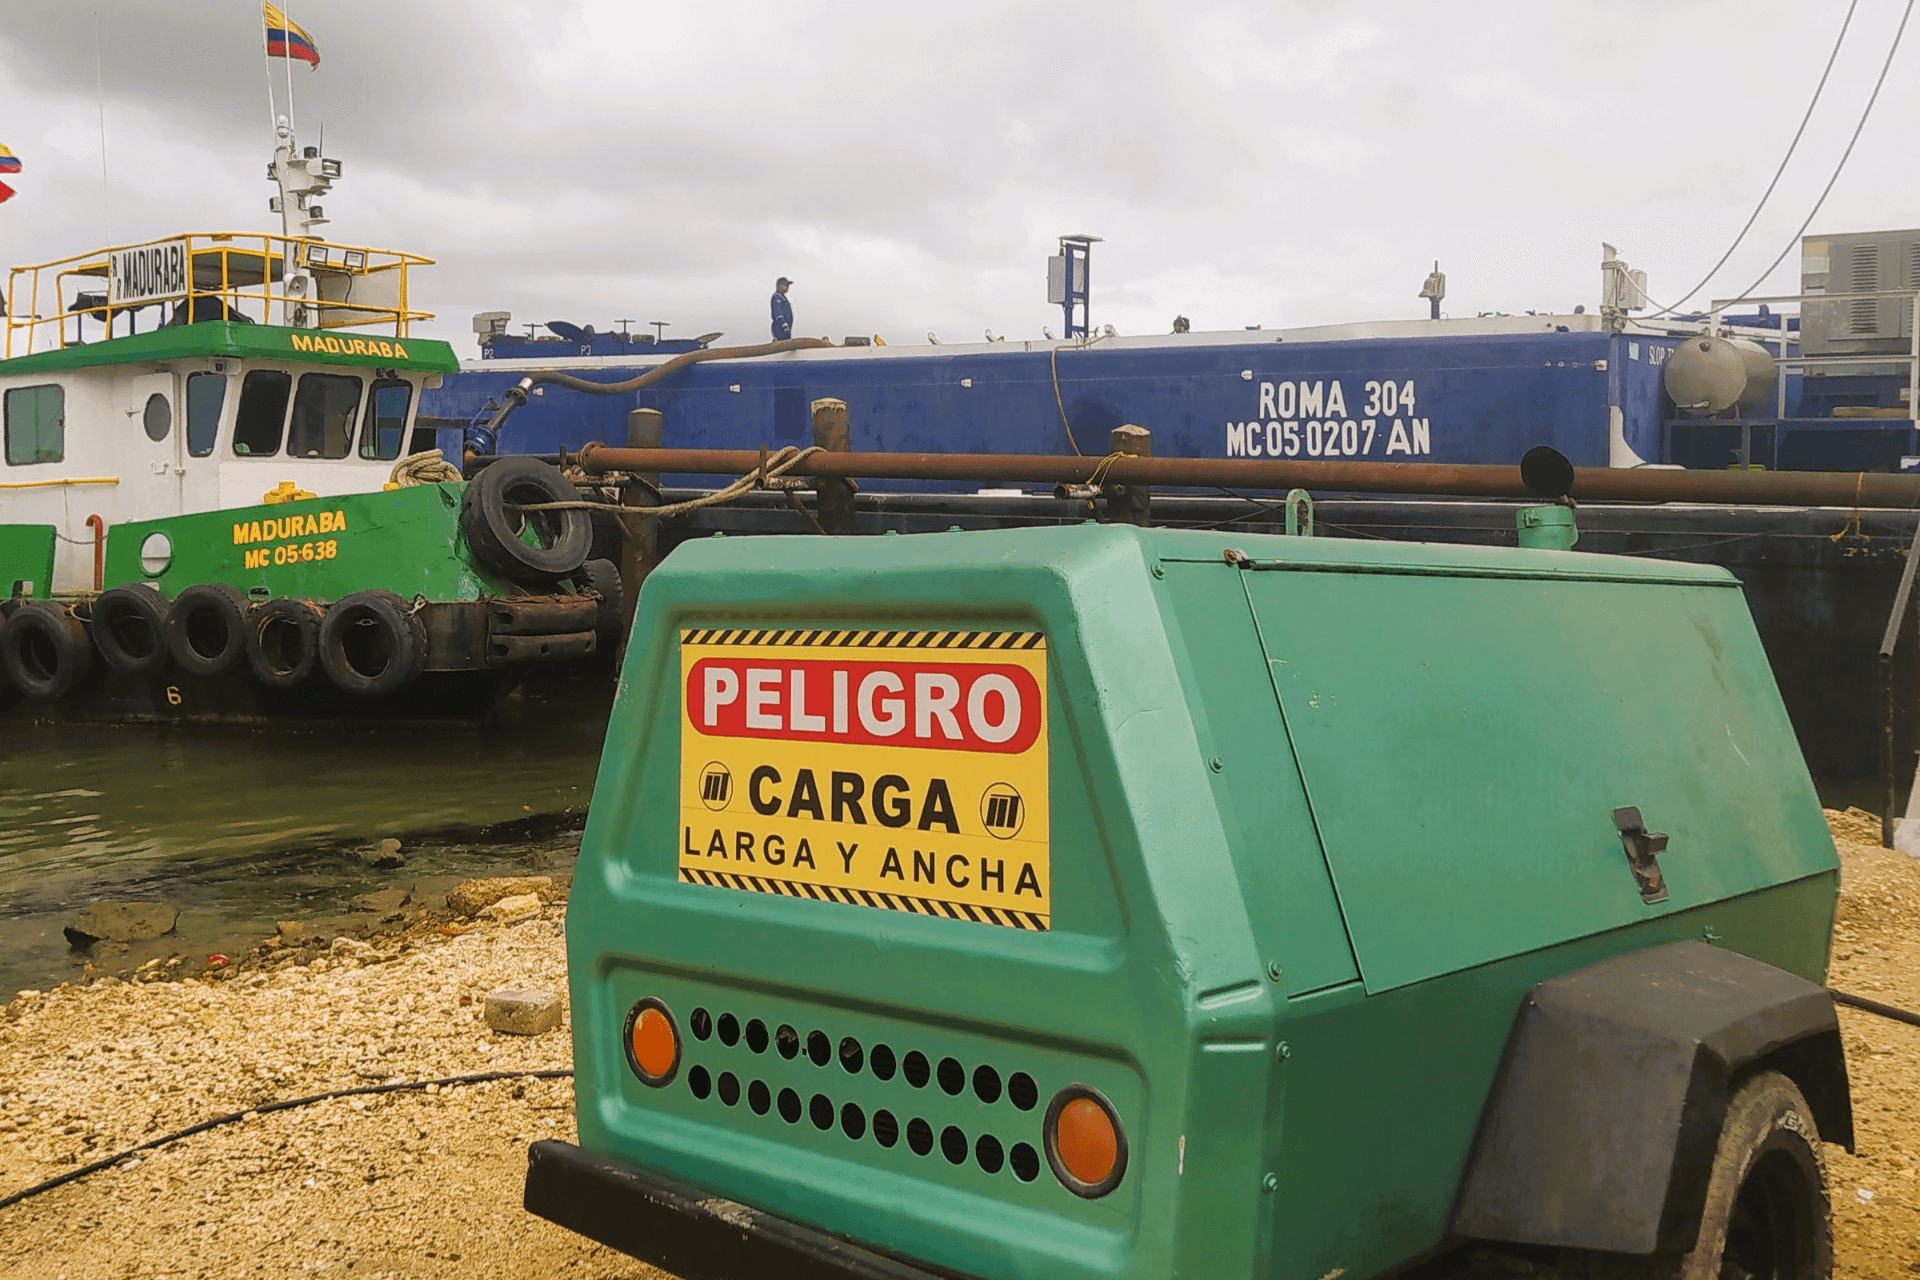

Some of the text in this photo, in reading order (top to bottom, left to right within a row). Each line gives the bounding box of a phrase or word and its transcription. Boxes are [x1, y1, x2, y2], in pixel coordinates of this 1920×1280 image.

[123, 244, 186, 299] MADURABA
[291, 334, 409, 359] MADURABA
[484, 348, 495, 359] P2
[580, 344, 592, 356] P3
[1259, 380, 1416, 419] ROMA 304
[233, 510, 346, 545] MADURABA
[244, 548, 271, 570] MC
[166, 685, 182, 705] 6
[703, 666, 1022, 744] PELIGRO
[748, 765, 961, 835] CARGA
[684, 825, 1043, 899] LARGA Y ANCHA
